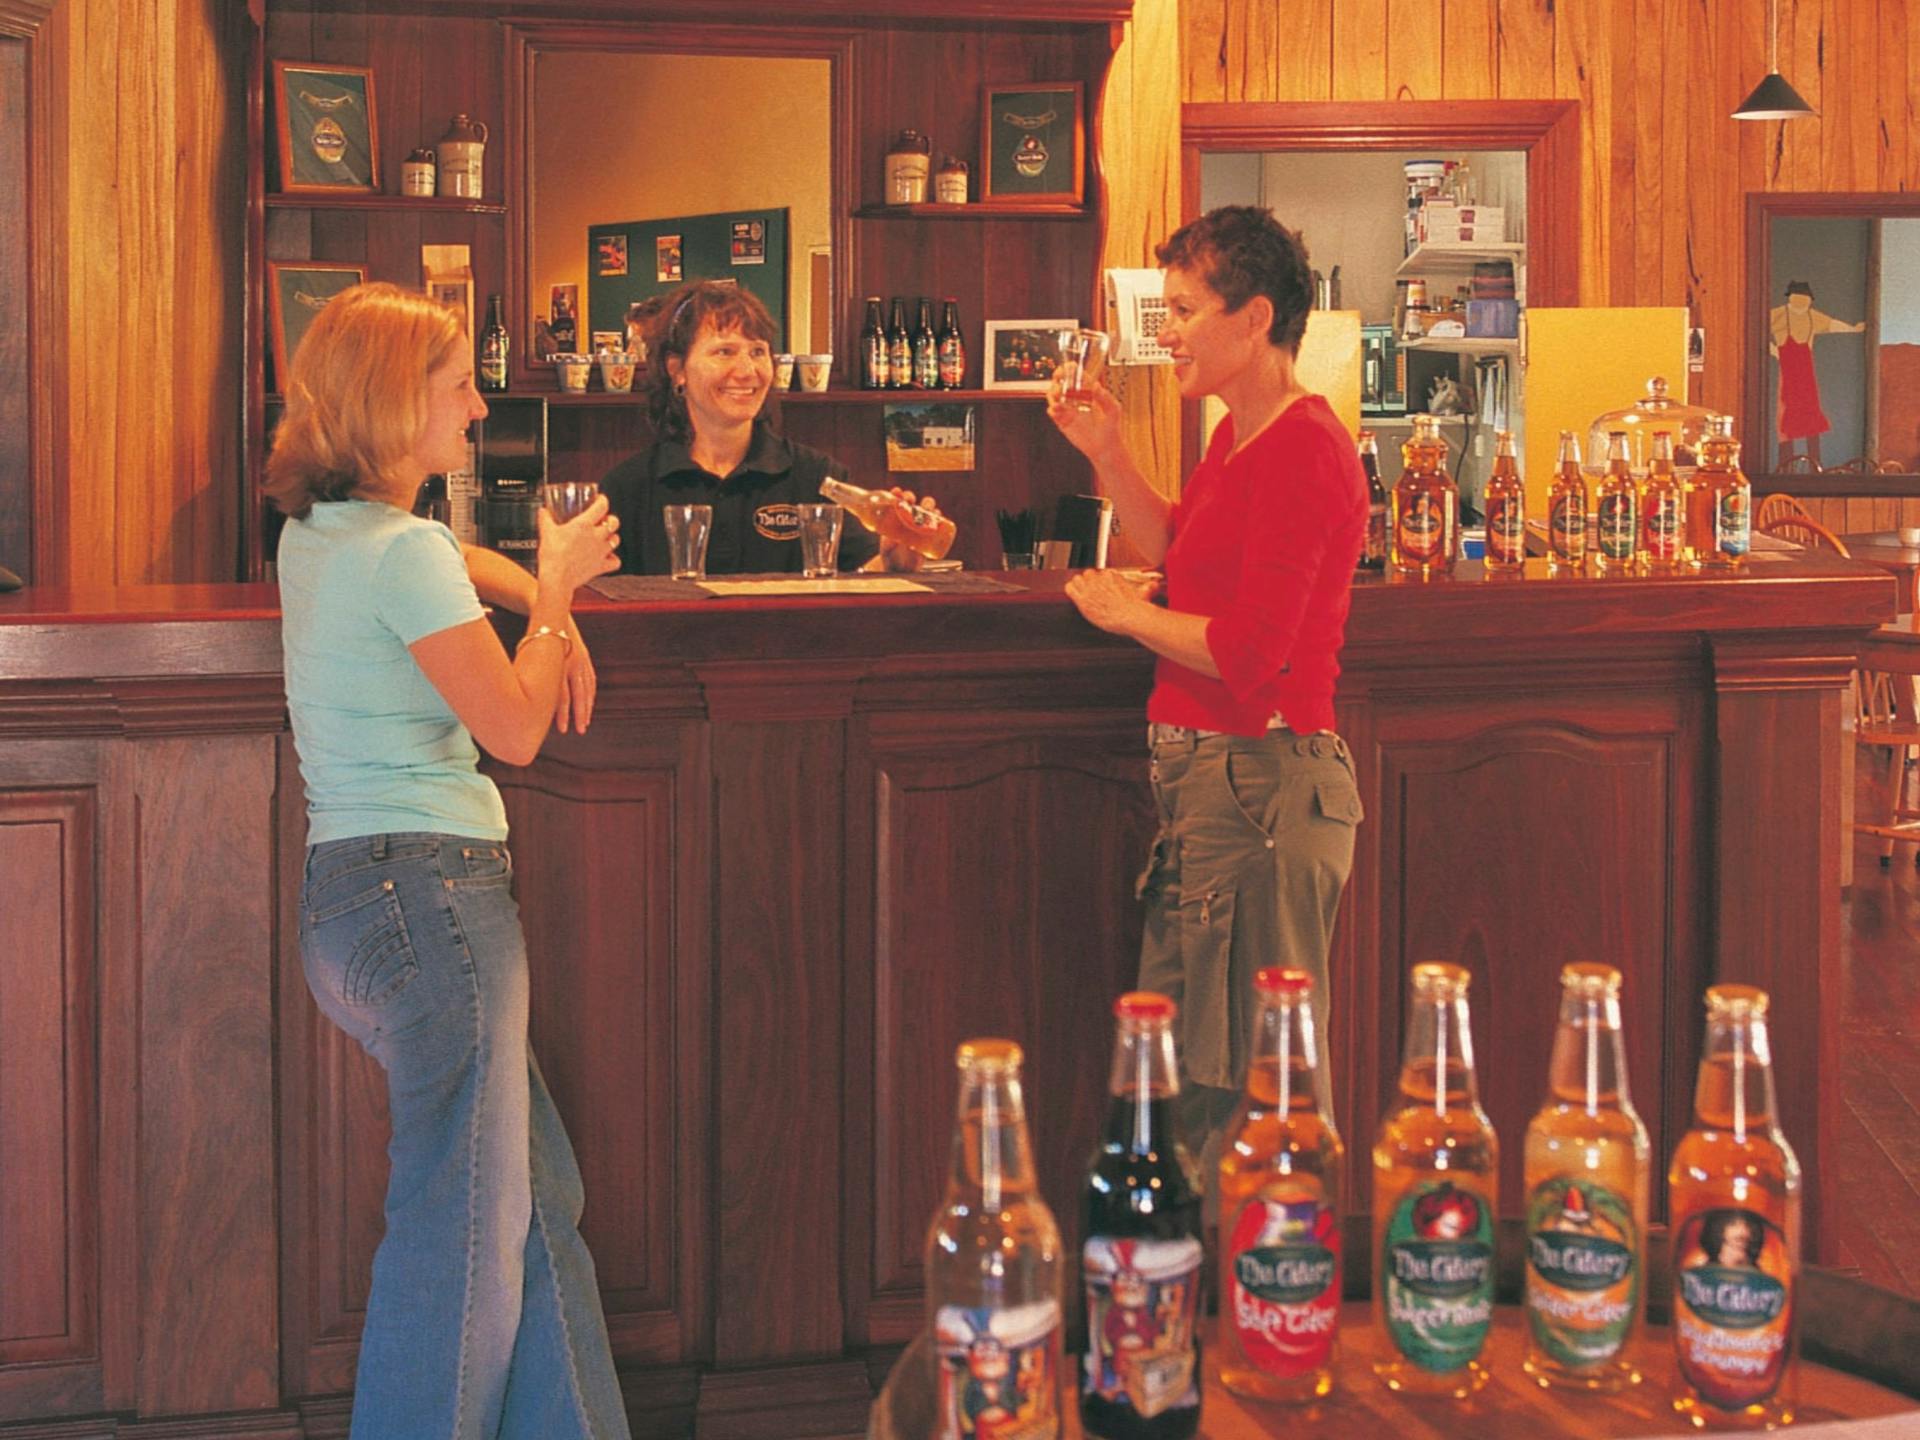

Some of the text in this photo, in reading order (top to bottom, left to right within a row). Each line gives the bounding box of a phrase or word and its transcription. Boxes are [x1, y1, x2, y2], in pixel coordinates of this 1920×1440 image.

[757, 512, 775, 526] The
[1242, 1255, 1333, 1287] The Cidery
[1393, 1249, 1490, 1283] The Cidery
[1528, 1236, 1630, 1281] The Cidery
[1680, 1272, 1783, 1316] The Cidery
